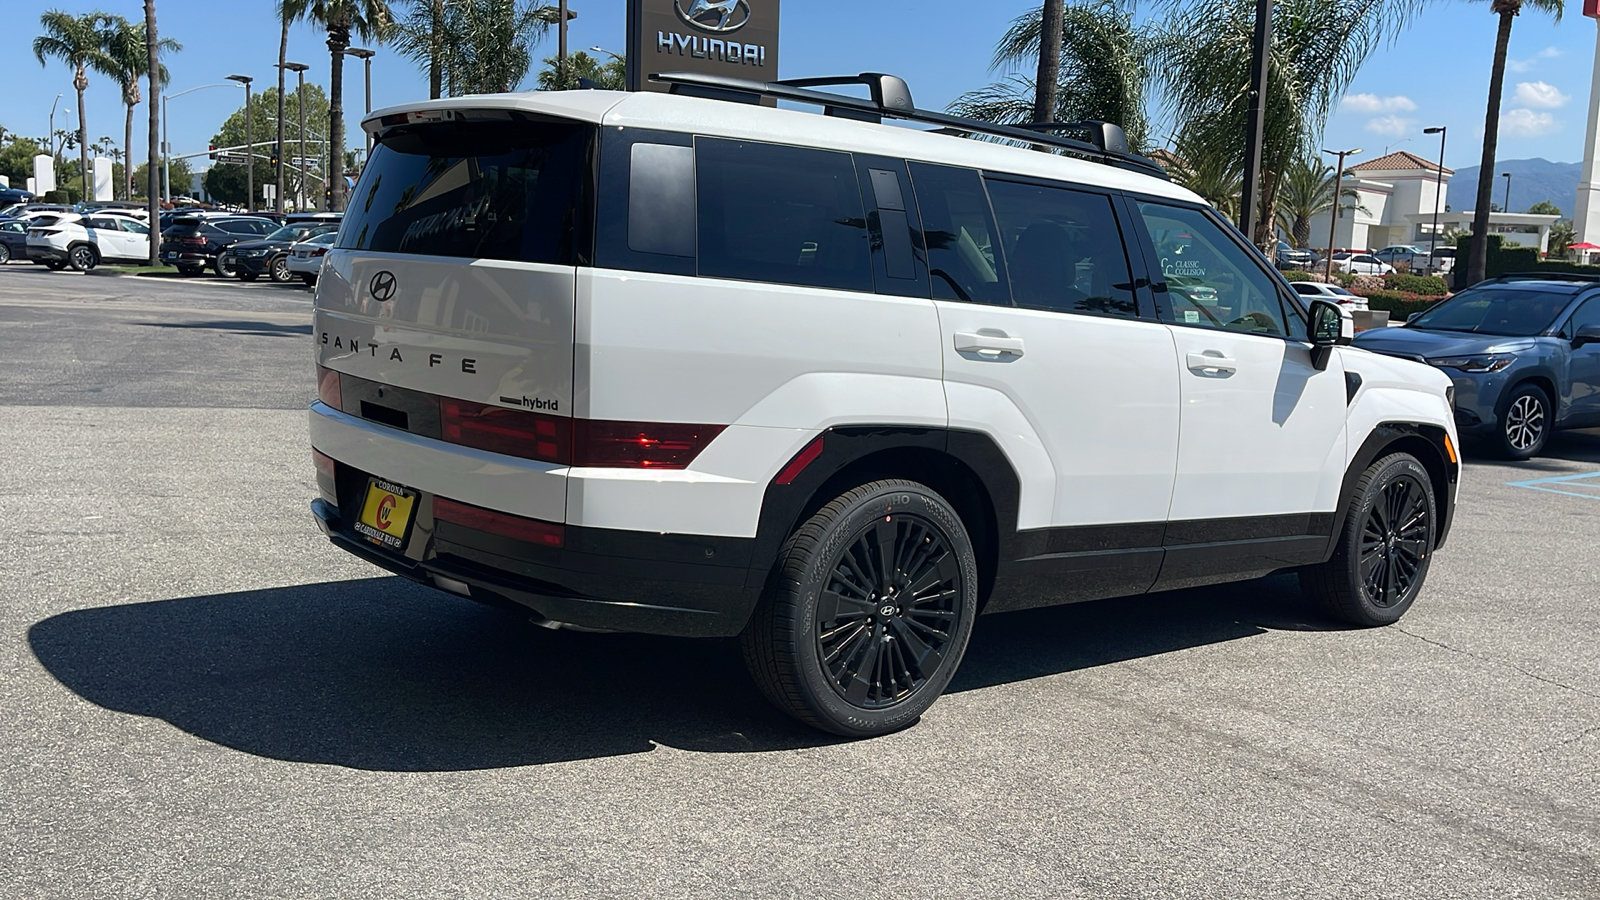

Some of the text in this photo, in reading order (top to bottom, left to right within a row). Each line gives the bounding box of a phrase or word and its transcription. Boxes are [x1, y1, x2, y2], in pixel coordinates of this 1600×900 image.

[657, 30, 765, 66] HYUNDAI
[1174, 268, 1206, 276] COLLISION
[1175, 260, 1200, 268] CLASSIC
[321, 332, 477, 375] SANTA FE
[522, 395, 559, 412] hybrid
[378, 480, 404, 496] CORONA
[384, 534, 396, 546] WAY
